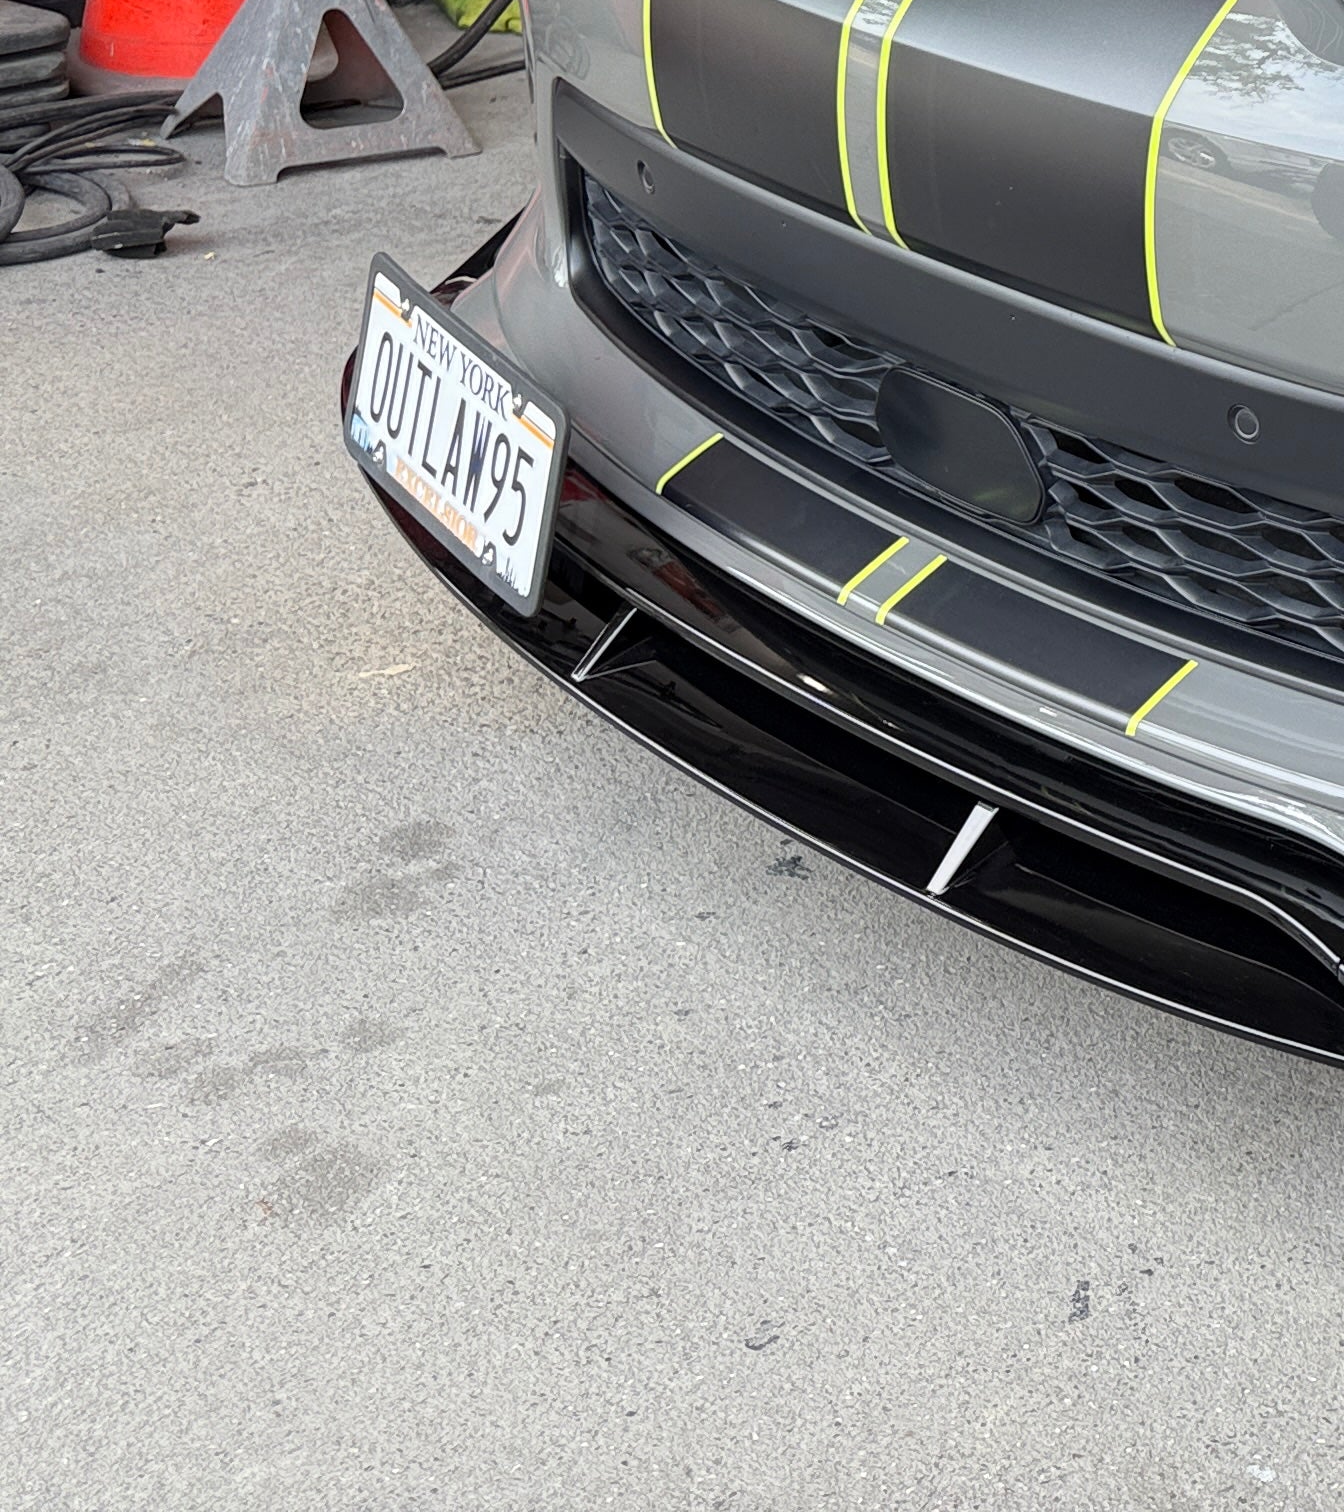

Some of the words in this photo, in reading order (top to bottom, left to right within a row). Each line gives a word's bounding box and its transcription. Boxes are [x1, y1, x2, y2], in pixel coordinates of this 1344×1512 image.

[413, 314, 457, 372] NEW
[460, 350, 511, 421] YORK
[369, 331, 535, 548] OUTLAW95
[395, 457, 479, 550] EXCELSIOR
